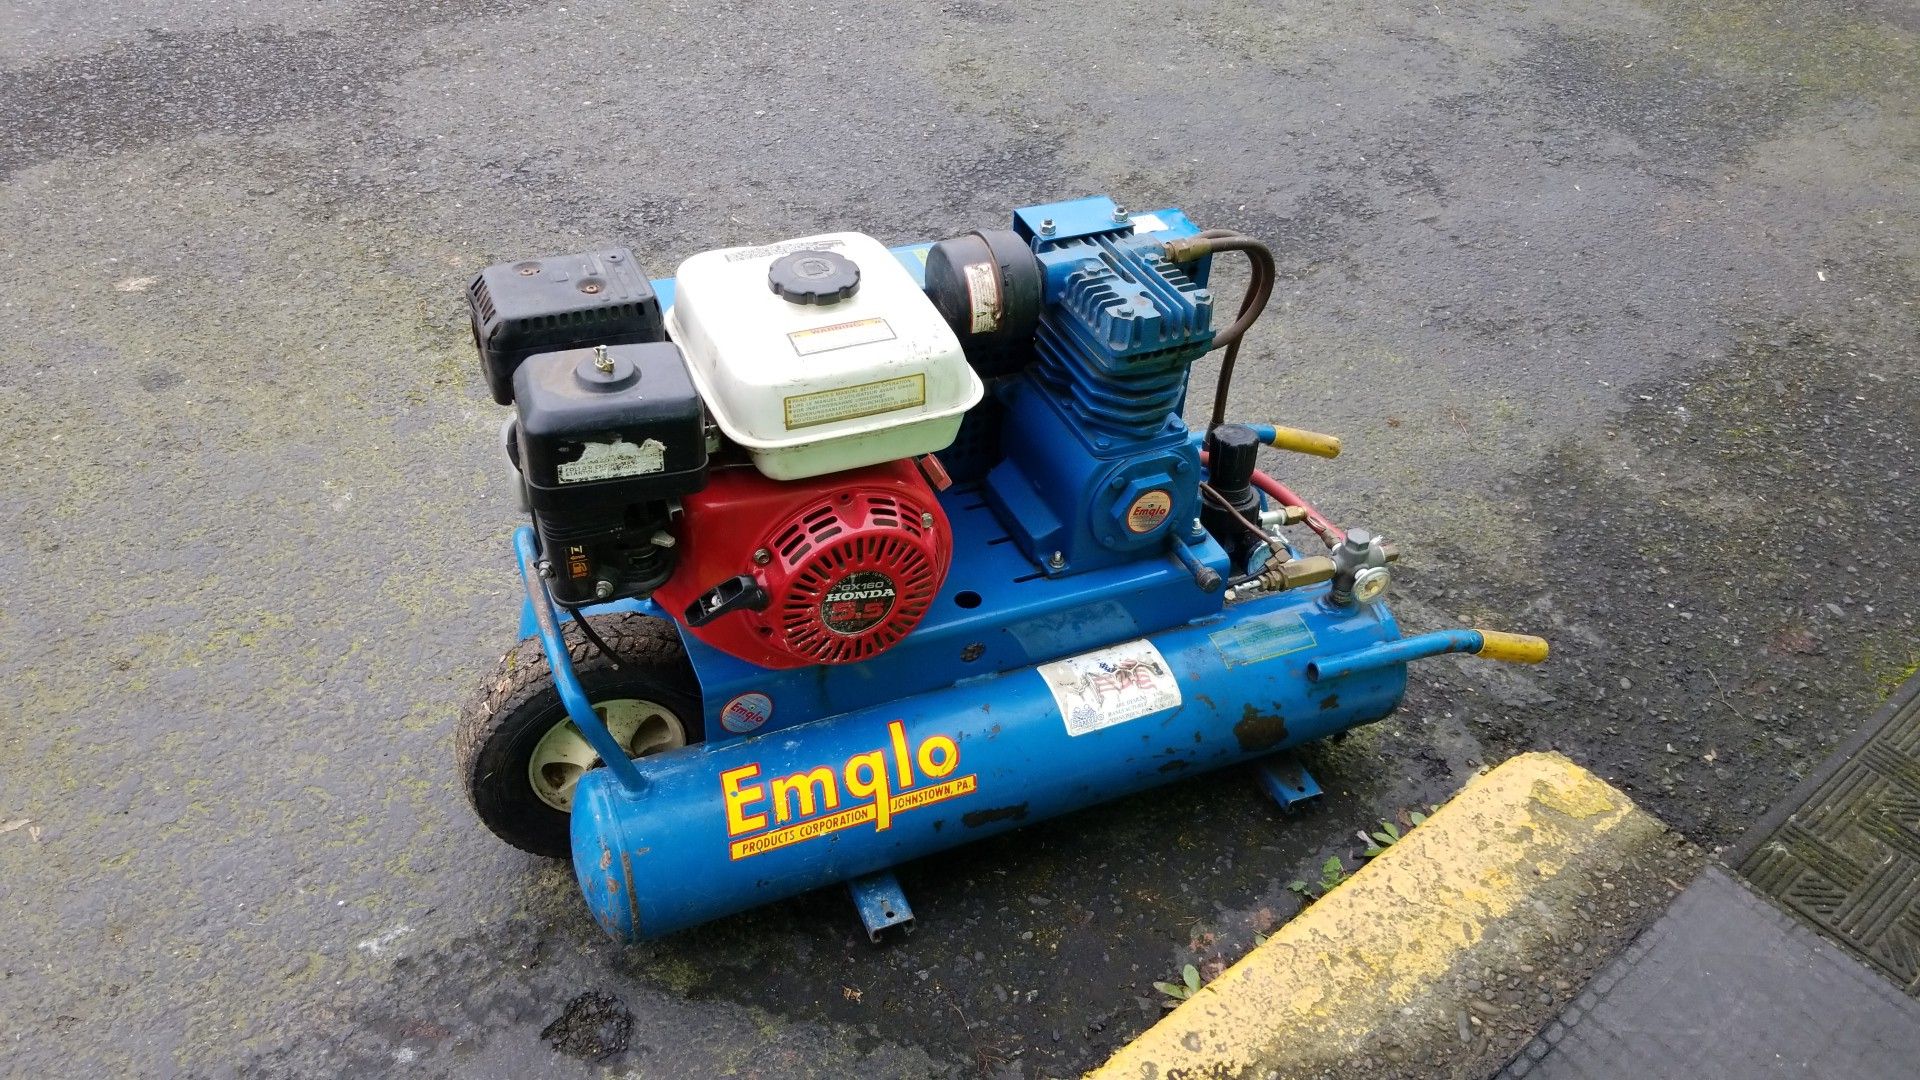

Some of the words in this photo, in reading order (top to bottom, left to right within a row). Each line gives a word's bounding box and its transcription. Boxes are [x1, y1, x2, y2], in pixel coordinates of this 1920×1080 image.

[826, 588, 896, 602] HONDA
[742, 829, 795, 855] PRODUCTS
[799, 808, 868, 838] CORPORATION
[893, 782, 954, 810] JOHNSTOWN,
[956, 779, 971, 792] PA.
